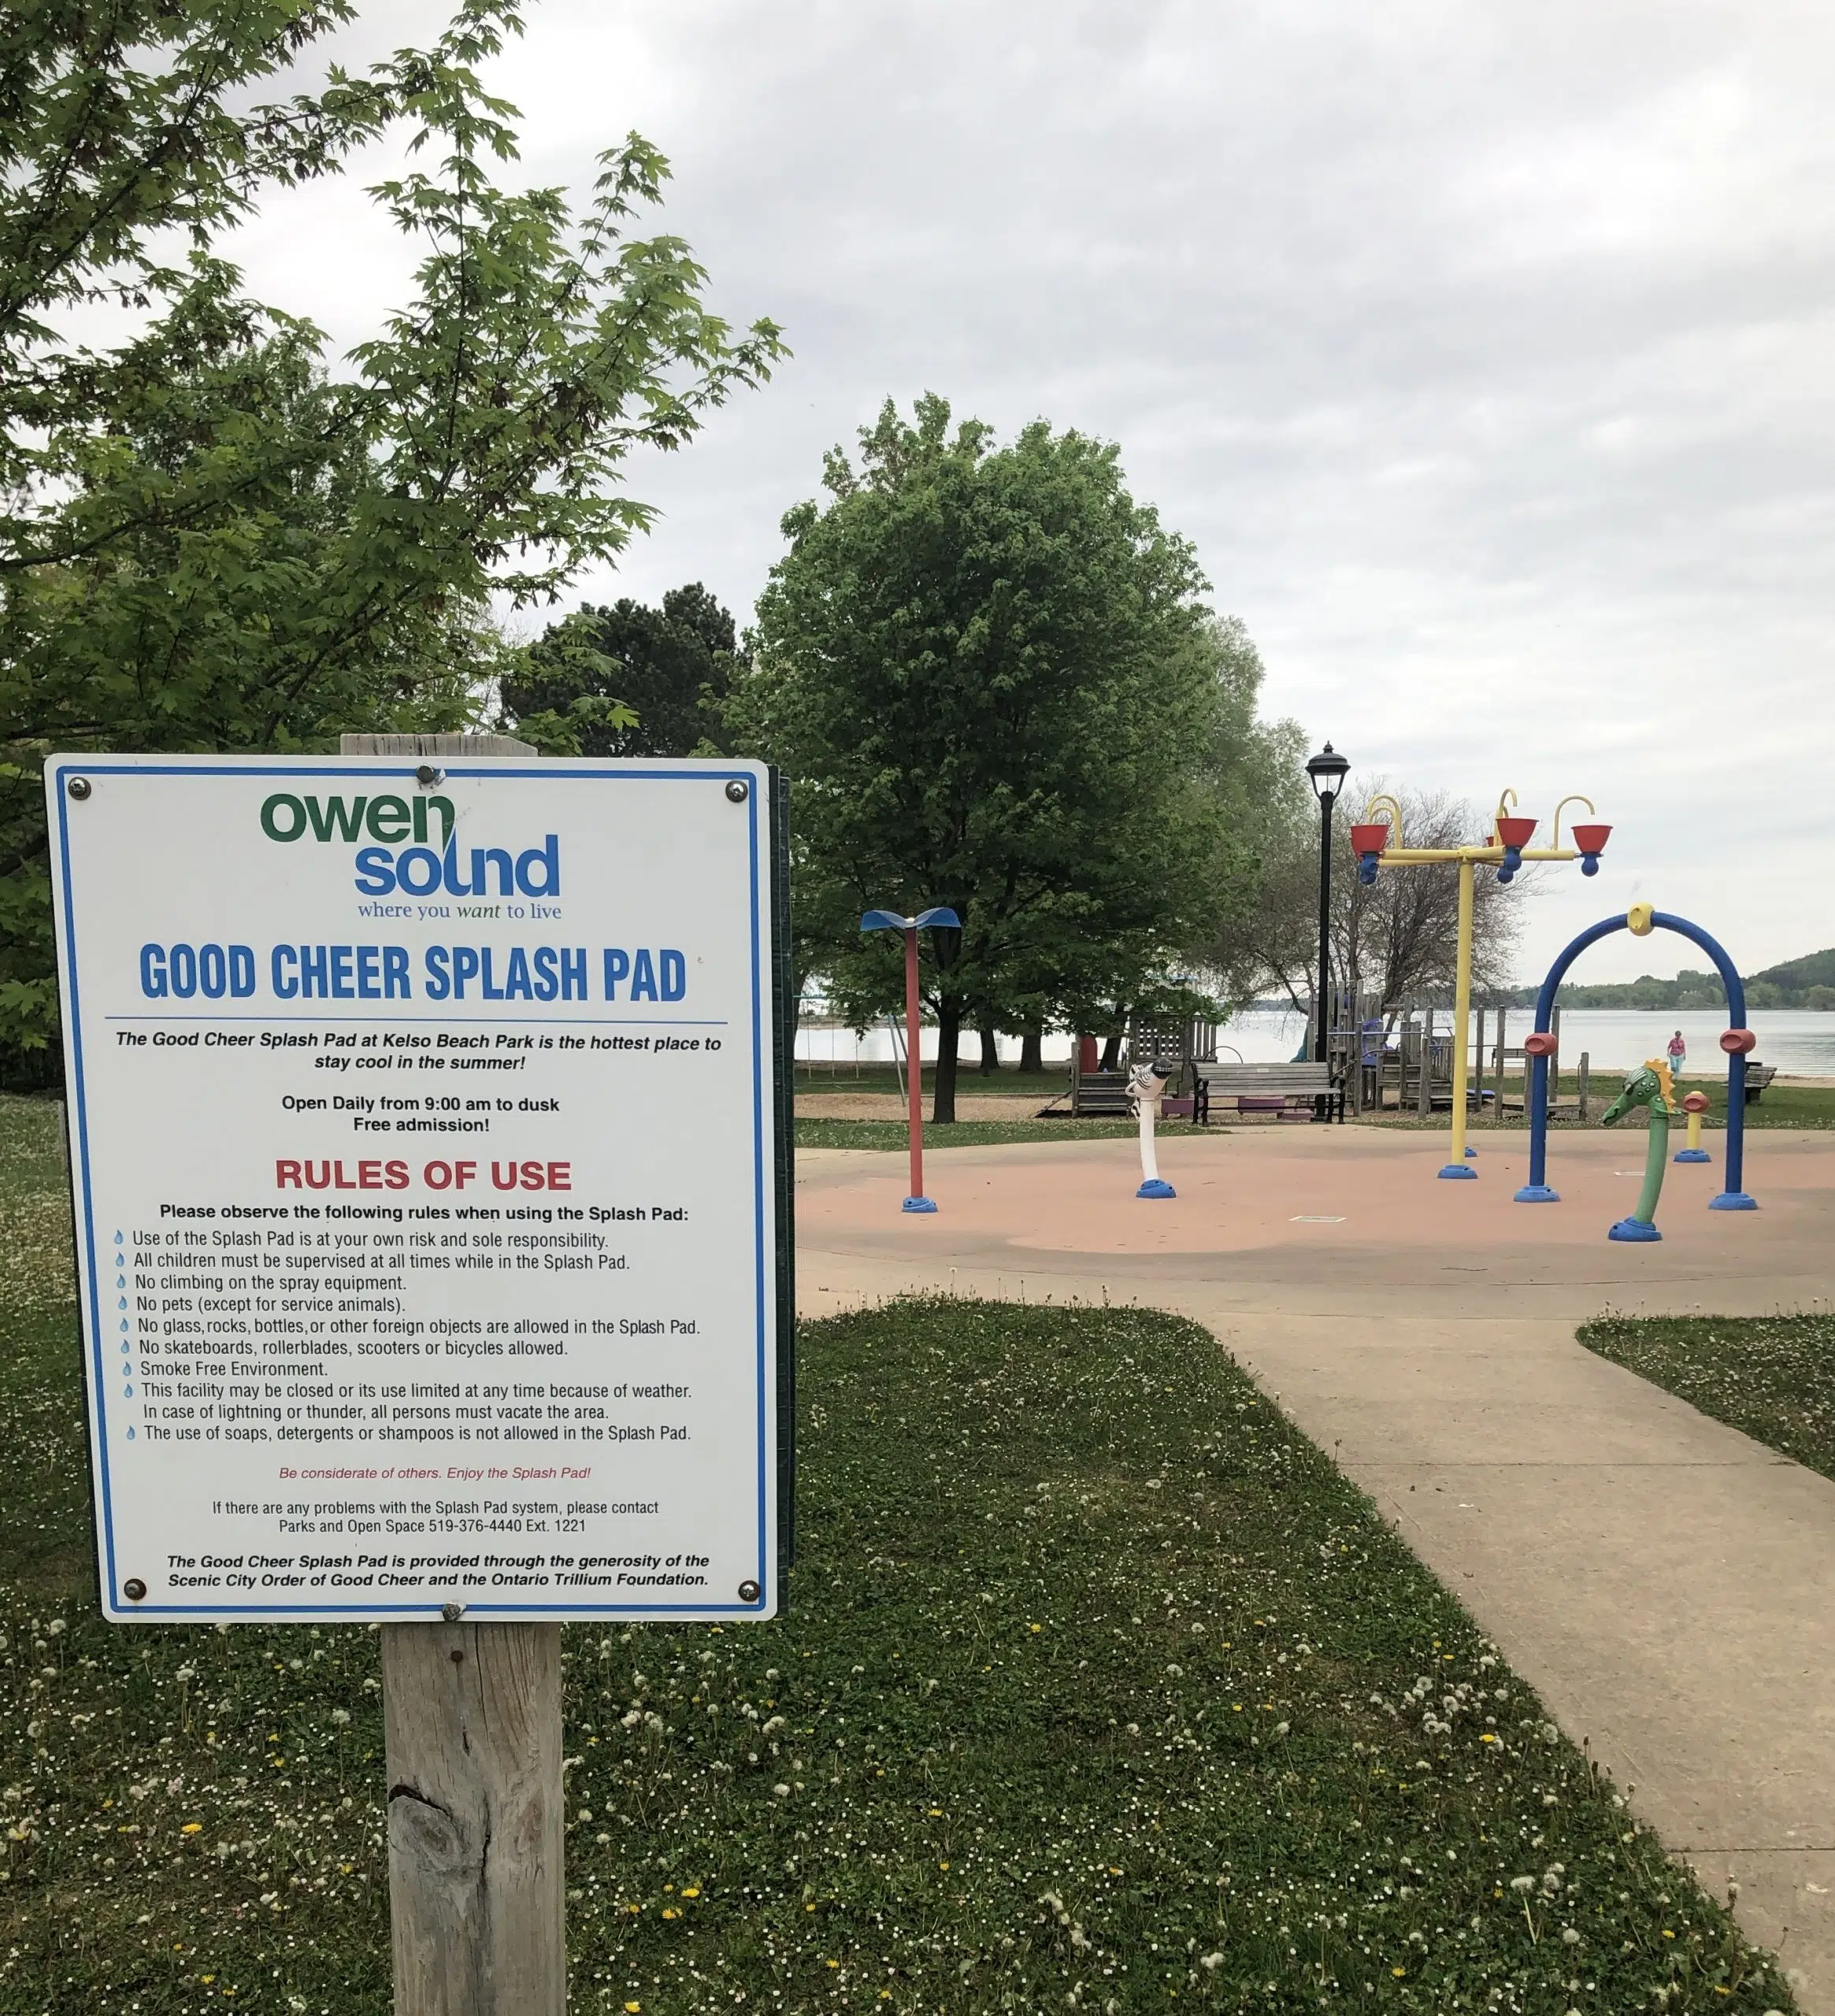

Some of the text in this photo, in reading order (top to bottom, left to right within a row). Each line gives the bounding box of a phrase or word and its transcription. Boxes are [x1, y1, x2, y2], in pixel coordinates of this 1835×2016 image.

[261, 793, 455, 849] owen
[354, 828, 560, 897] sound
[358, 901, 562, 921] where you want to live
[139, 943, 686, 1002] GOOD CHEER SPLASH PAD
[116, 1032, 721, 1054] The Good Cheer Splash Pad at Kelso Beach Park is the hottest place to
[314, 1054, 526, 1072] stay cool in the summer!
[282, 1095, 560, 1114] Open Daily from 9:00 am to dusk
[354, 1117, 489, 1132] Free admission!
[276, 1160, 572, 1191] RULES OF USE
[160, 1204, 688, 1224] Please observe the following rules when using the Splash Pad:
[132, 1230, 608, 1251] Use of the Splash Pad is at your own risk and sole responsibility.
[135, 1274, 406, 1293] No climbing on the spray equipment.
[136, 1295, 406, 1315] No pets (except for service animals).
[139, 1339, 568, 1358] No skateboards, rollerblades, scooters or bicycles allowed.
[140, 1361, 328, 1377] Smoke Free Environment.
[143, 1403, 609, 1422] In case of lightning or thunder, all persons must vacate the area.
[279, 1467, 591, 1482] Be considerate of others. Enjoy the Splash Pad!
[213, 1500, 659, 1517] If there are any problems with the Splash Pad system, please contact
[279, 1518, 585, 1536] Parks and Open Space 519-376-4440 Ext. 1221
[167, 1555, 710, 1571] The Good Cheer Splash Pad is provided through the generosity of the
[168, 1573, 708, 1590] Scenic City Order of Good Cheer and the Ontario Trillium Foundation.
